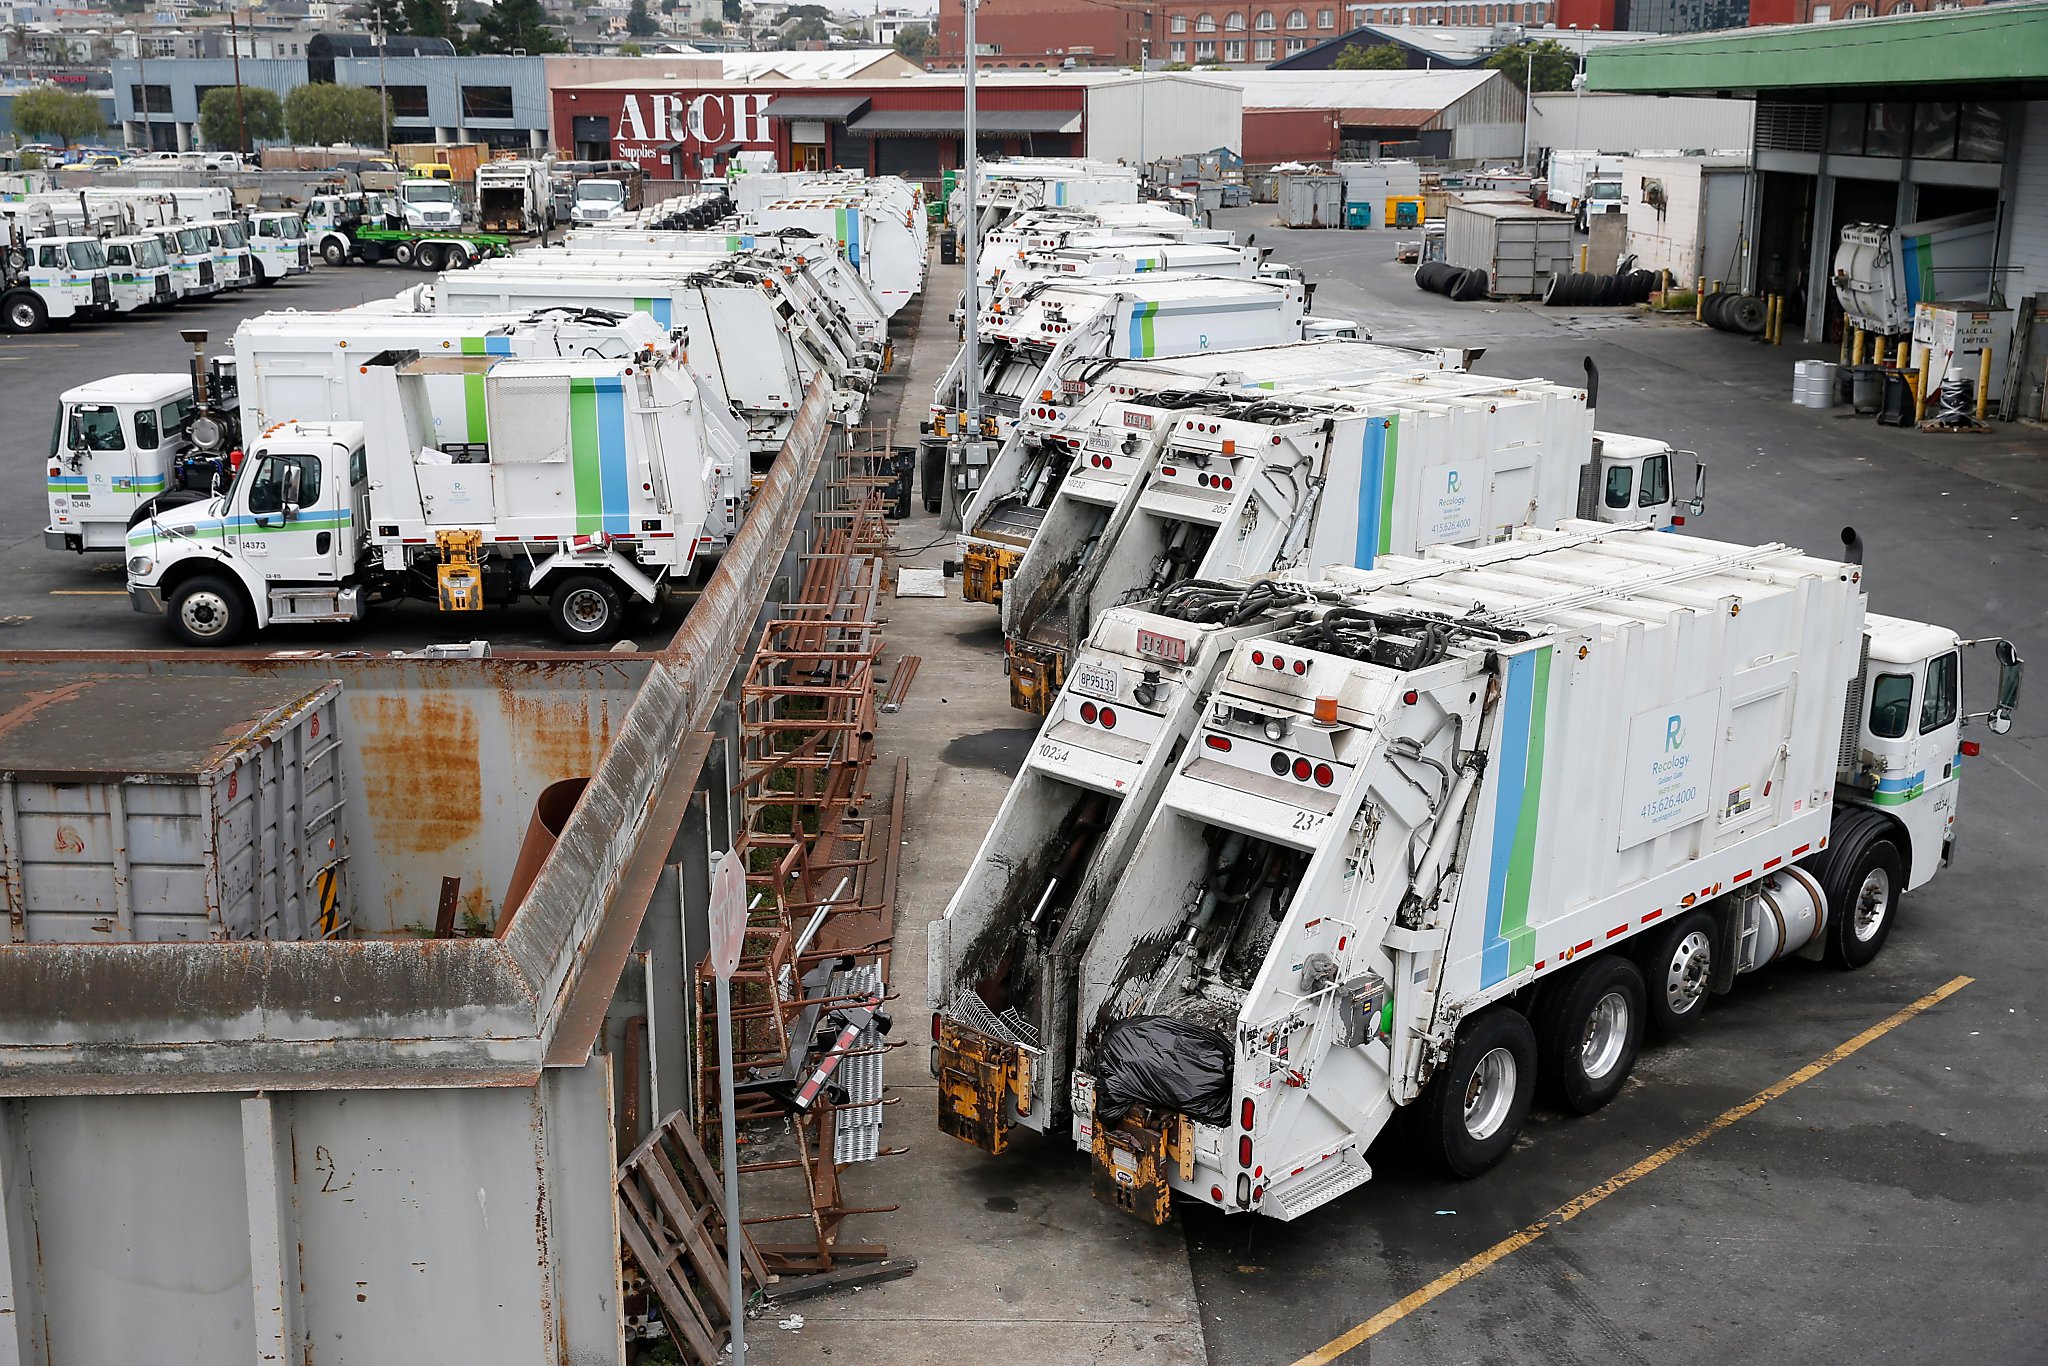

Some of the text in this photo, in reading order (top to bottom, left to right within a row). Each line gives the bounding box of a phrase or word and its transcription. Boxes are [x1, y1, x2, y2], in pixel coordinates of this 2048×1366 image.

[613, 93, 774, 143] ARCH
[619, 142, 657, 162] Supplies
[1981, 327, 1993, 335] ALL
[1199, 334, 1211, 349] R
[1063, 381, 1084, 394] HEIL
[1125, 412, 1149, 428] HEIL
[454, 482, 463, 491] R
[1447, 470, 1462, 494] R
[71, 501, 91, 509] 10416
[1438, 496, 1466, 507] Recology
[1211, 504, 1229, 515] 205
[1431, 518, 1471, 533] 415.626.4000
[242, 541, 266, 549] 14373
[1141, 634, 1180, 659] HEIL
[1081, 672, 1115, 692] 8P95133
[1664, 714, 1687, 753] R
[1038, 743, 1070, 763] 10234
[1652, 753, 1690, 775] Recology
[1658, 774, 1673, 785] Golden
[1640, 786, 1697, 818] 415.626.4000
